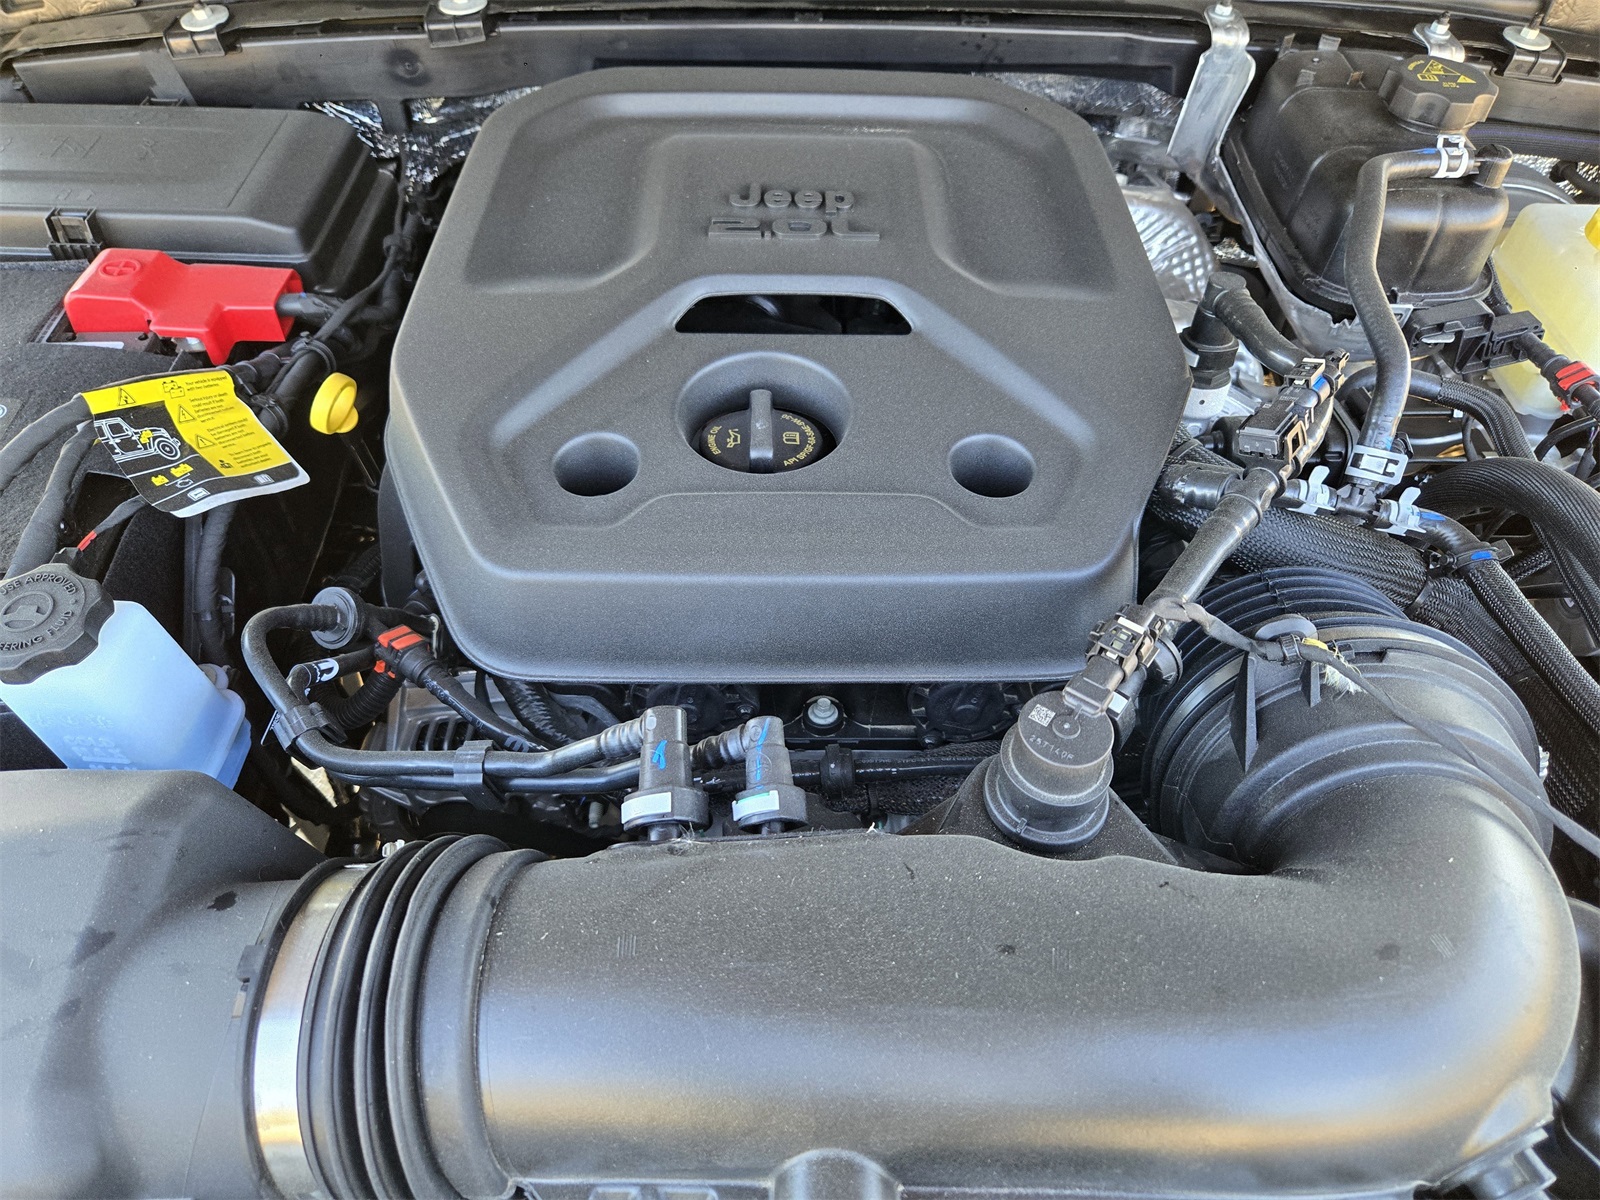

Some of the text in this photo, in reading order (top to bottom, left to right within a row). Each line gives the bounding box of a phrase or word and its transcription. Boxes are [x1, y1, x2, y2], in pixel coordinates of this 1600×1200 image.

[729, 183, 854, 217] Jeep
[708, 217, 880, 240] 2.0L
[707, 425, 723, 456] ENGINE OIL
[783, 457, 799, 466] API
[25, 573, 78, 596] APPROVED
[46, 611, 74, 636] FLUID
